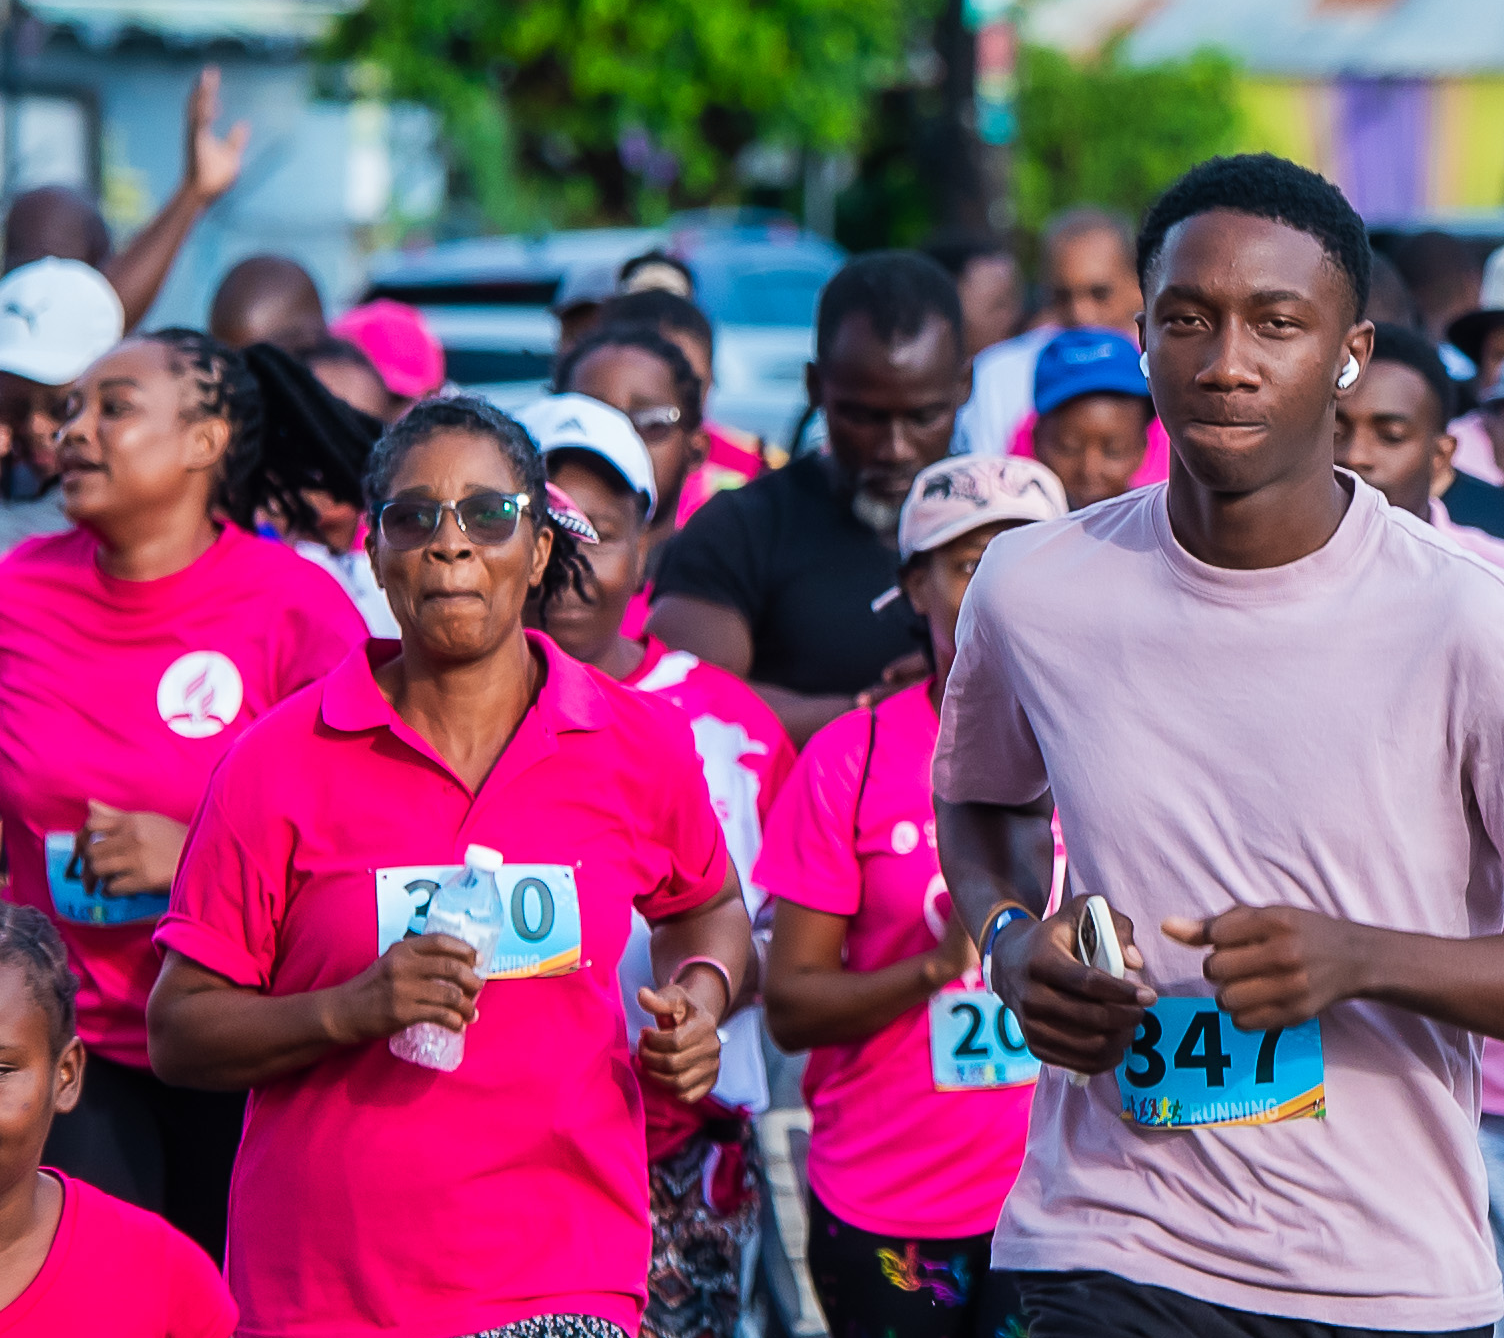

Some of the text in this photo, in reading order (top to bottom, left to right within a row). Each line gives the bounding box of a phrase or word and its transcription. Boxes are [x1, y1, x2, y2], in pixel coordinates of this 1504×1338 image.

[404, 876, 555, 941] 30
[950, 1002, 1027, 1057] 20
[1124, 1010, 1285, 1089] 347
[1190, 1097, 1280, 1123] RUNNING
